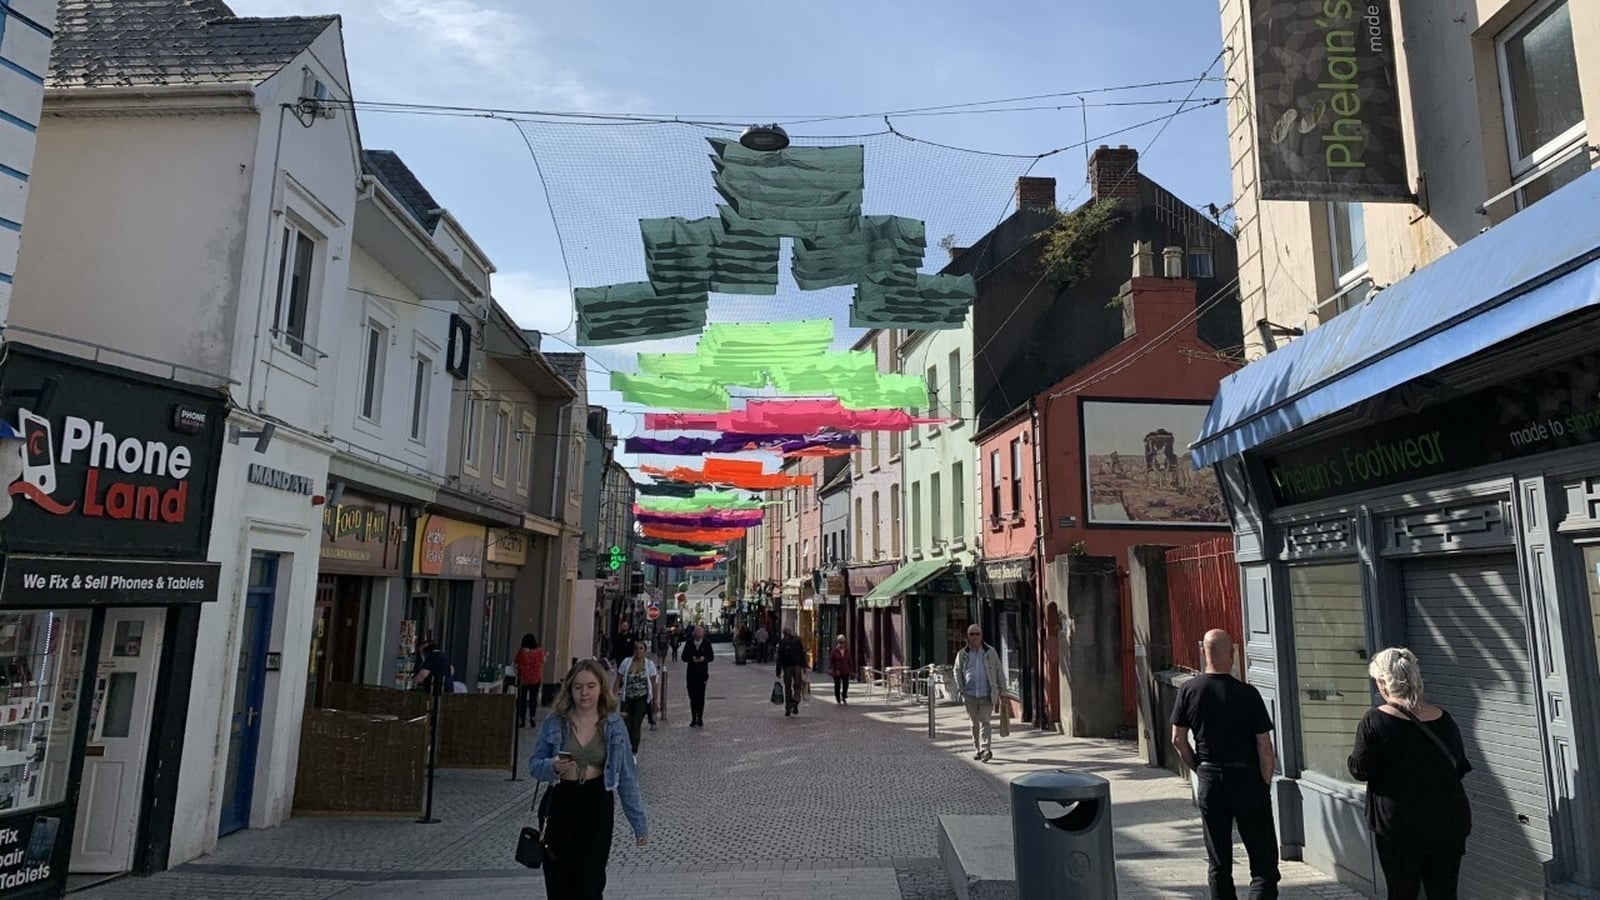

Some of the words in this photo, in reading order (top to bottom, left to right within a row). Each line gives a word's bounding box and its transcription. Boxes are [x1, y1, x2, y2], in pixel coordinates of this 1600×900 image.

[1363, 5, 1383, 52] made
[1315, 0, 1365, 168] Phelan's
[181, 409, 206, 422] PHONE
[1509, 421, 1548, 446] made
[1548, 418, 1564, 437] to
[60, 416, 191, 479] Phone
[1343, 430, 1444, 482] Footwear
[83, 468, 188, 523] Land
[248, 463, 315, 495] MANDATE
[23, 574, 45, 589] We
[49, 574, 69, 589] Fix
[71, 575, 81, 589] &
[84, 575, 108, 589] Sell
[110, 576, 154, 590] Phones
[156, 577, 164, 589] &
[167, 577, 204, 590] Tablets
[0, 864, 50, 889] Tablets
